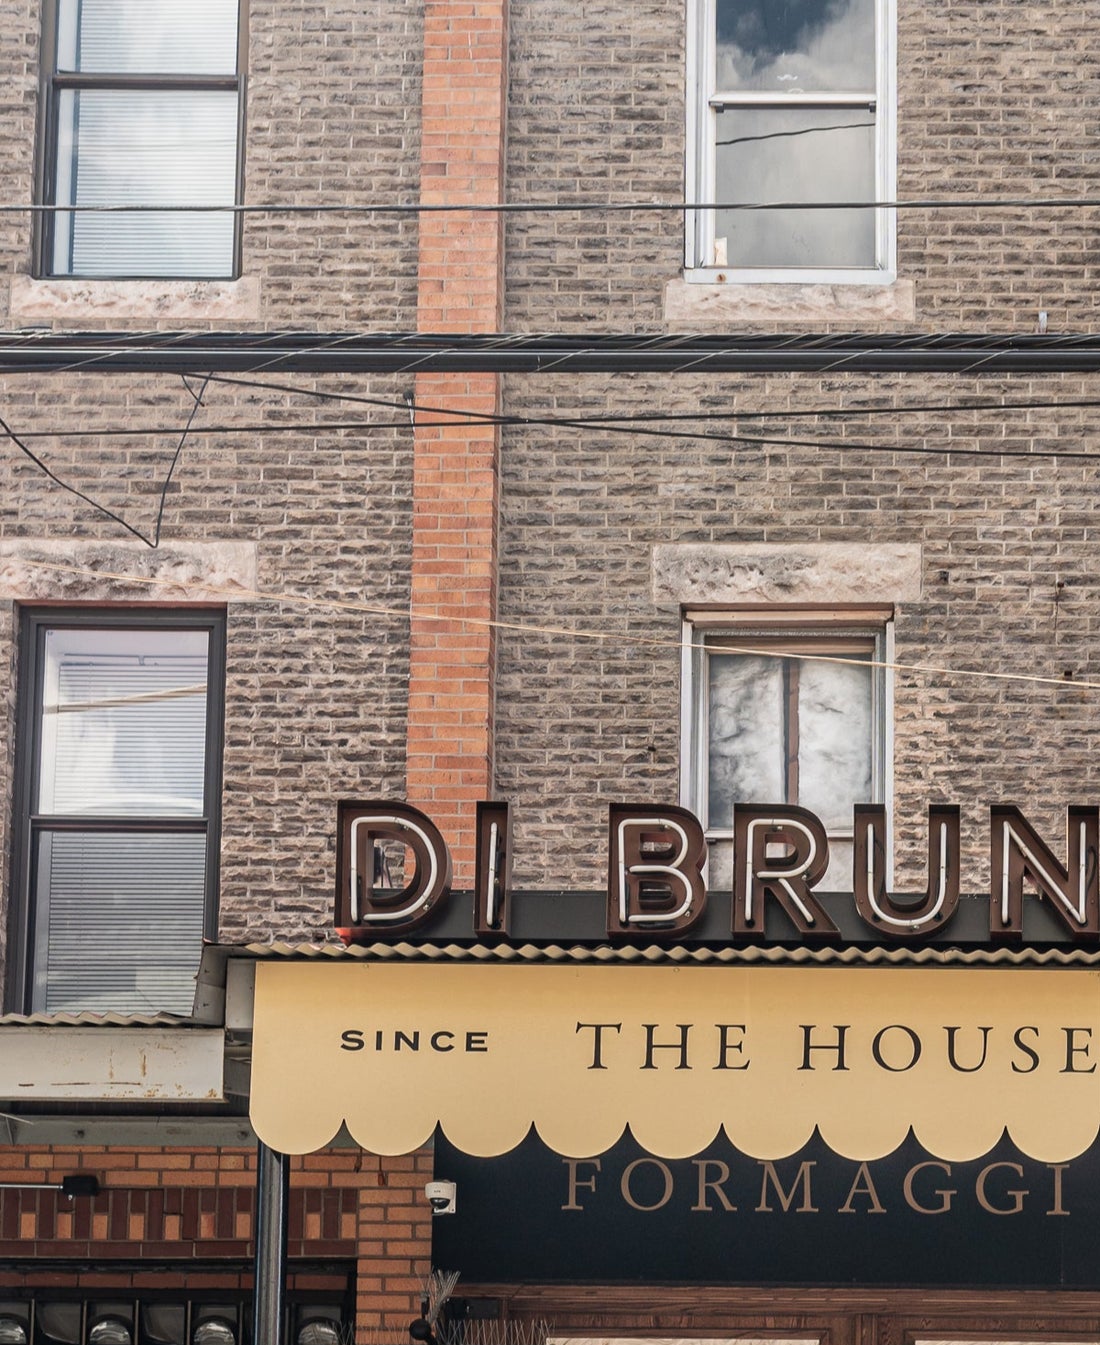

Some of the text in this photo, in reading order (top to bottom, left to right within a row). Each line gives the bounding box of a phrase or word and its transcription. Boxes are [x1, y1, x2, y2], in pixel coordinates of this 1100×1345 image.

[334, 800, 511, 939] DI
[340, 1030, 489, 1052] SINCE
[575, 1021, 752, 1071] THE
[796, 1024, 1098, 1075] HOUSE
[561, 1158, 1071, 1217] FORMAGGI
